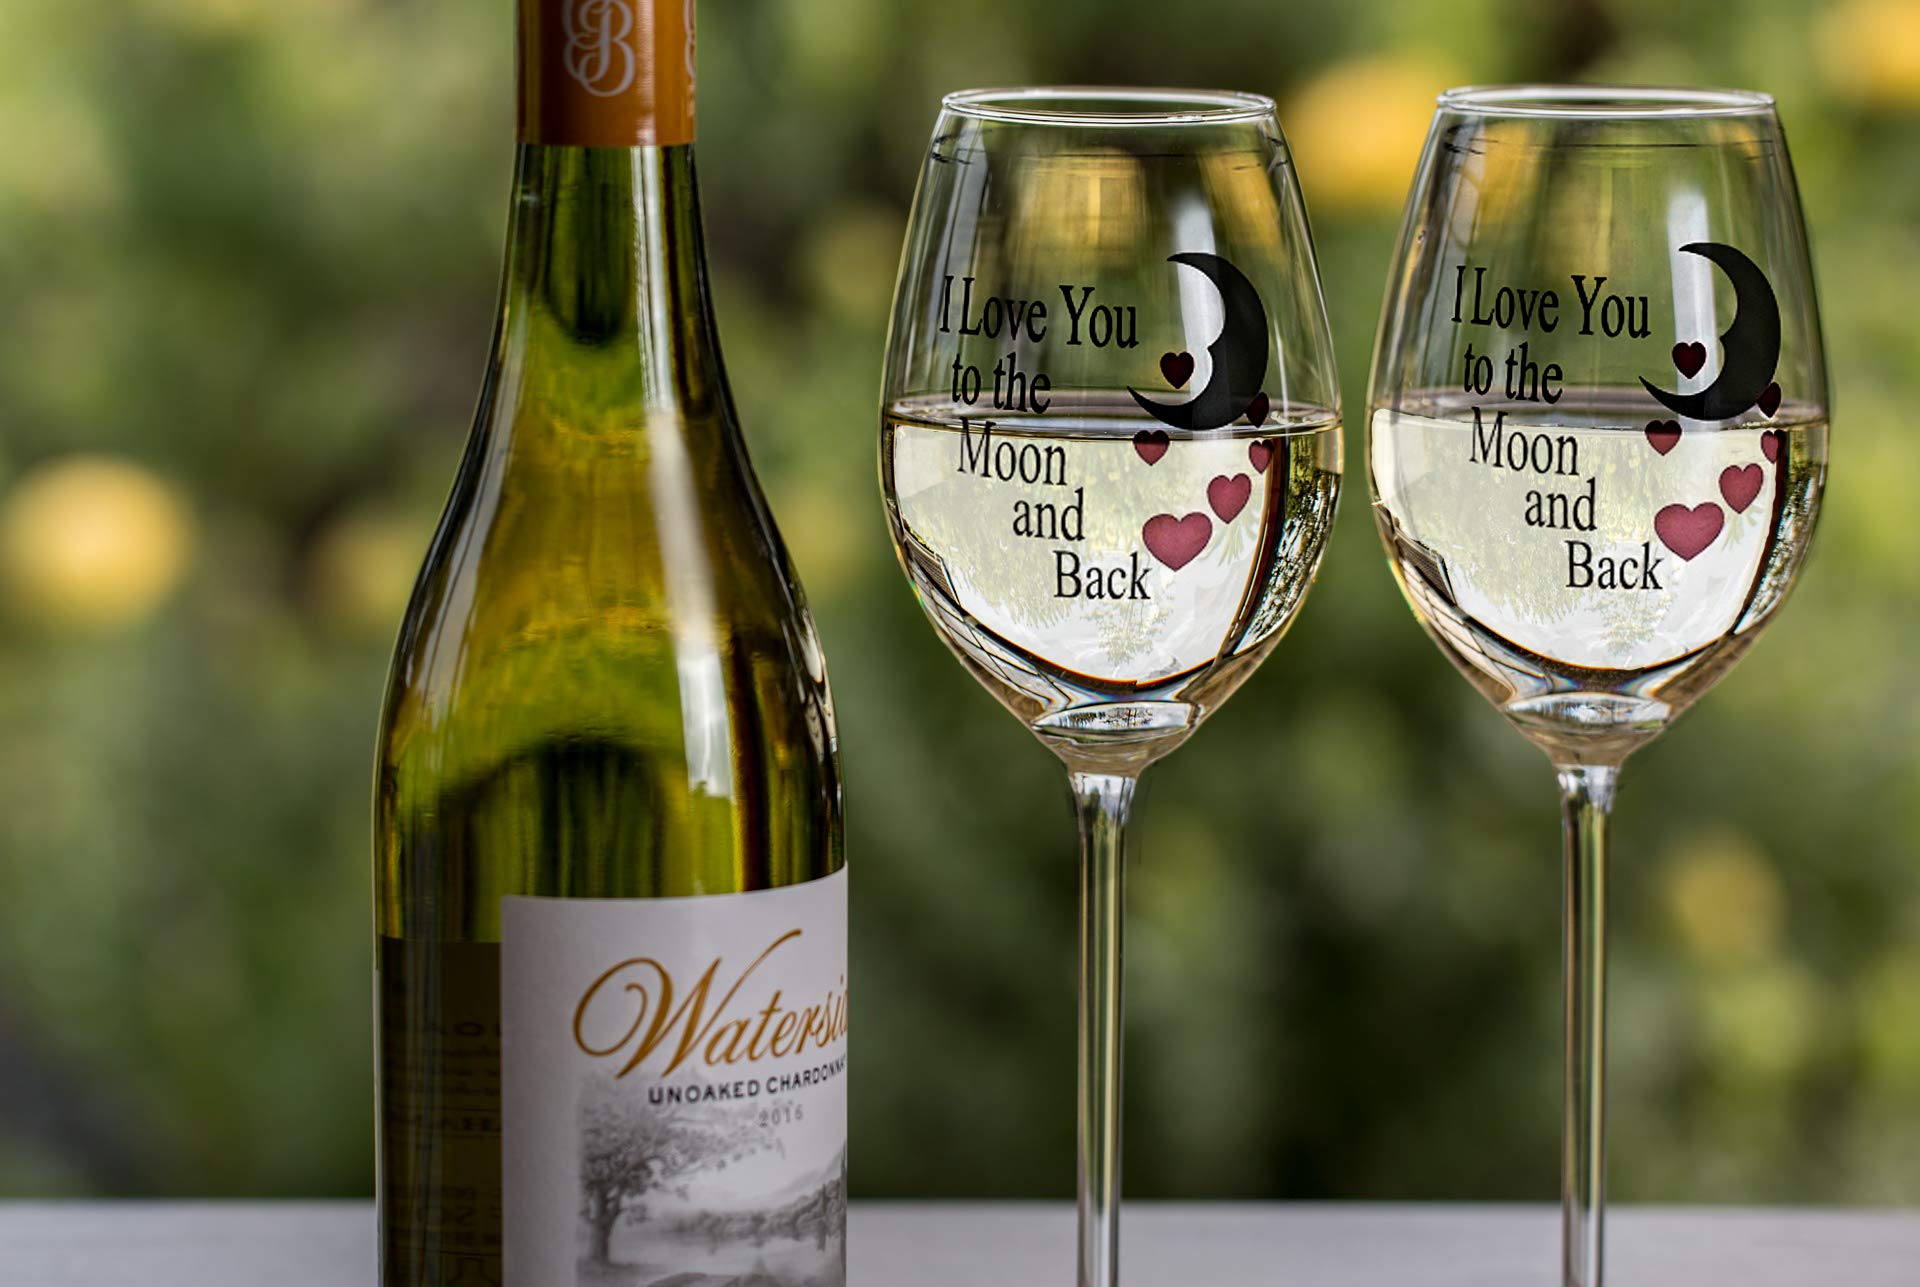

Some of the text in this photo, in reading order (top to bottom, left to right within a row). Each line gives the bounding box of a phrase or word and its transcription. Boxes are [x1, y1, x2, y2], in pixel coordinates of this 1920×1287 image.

[939, 275, 1140, 349] I Love You
[1450, 265, 1652, 339] I Love You
[951, 352, 1052, 415] to the
[1463, 342, 1563, 404] to the
[957, 416, 1068, 486] Moon
[1469, 406, 1579, 476] Moon
[1012, 487, 1086, 542] and
[1524, 477, 1598, 532] and
[1053, 549, 1152, 601] Back
[1565, 541, 1664, 591] Back
[648, 1079, 760, 1105] UNOAKED
[758, 1104, 804, 1128] 2016
